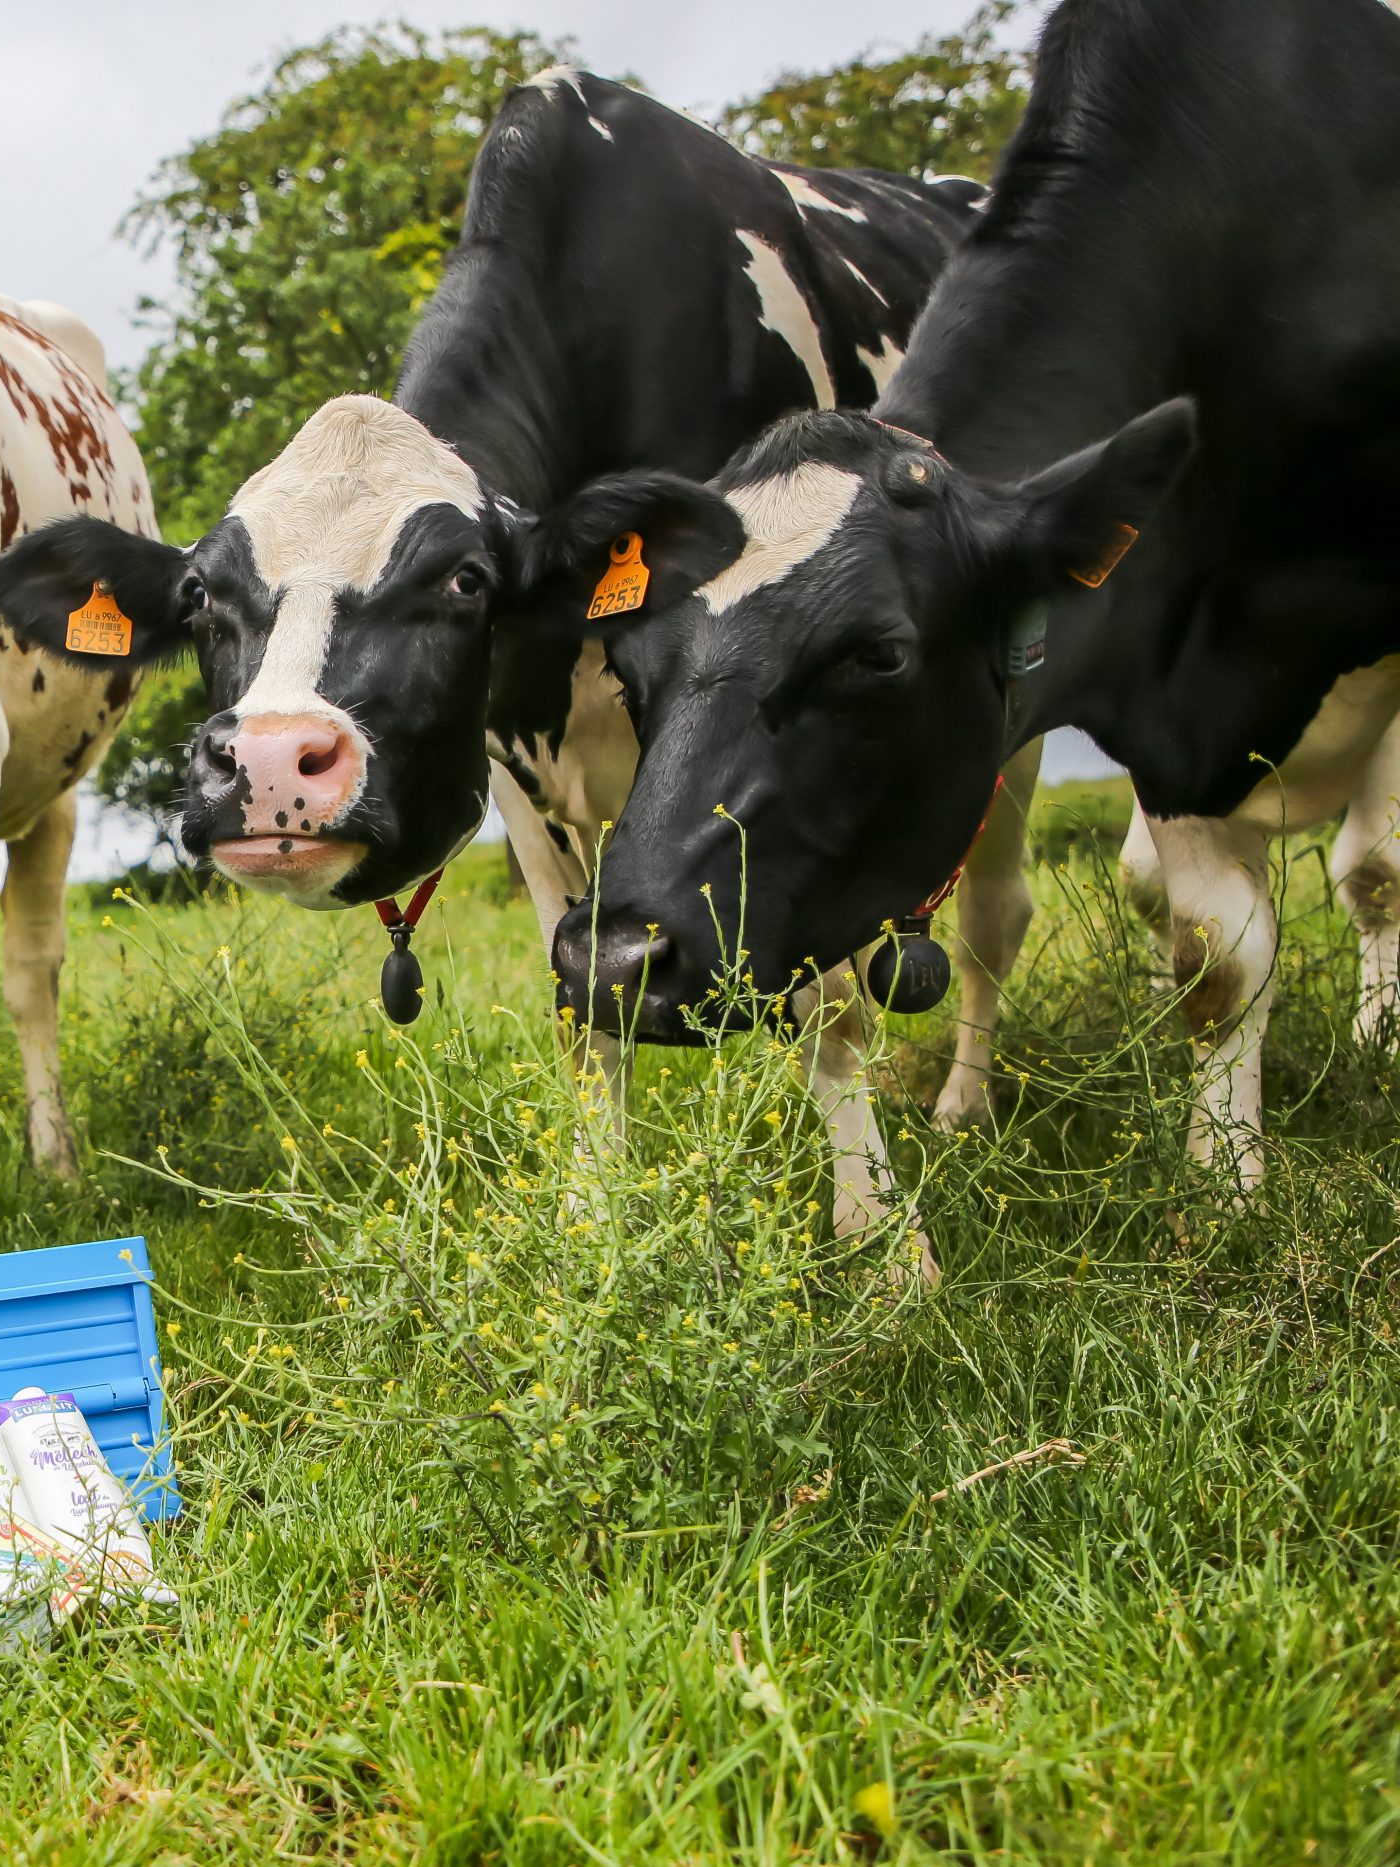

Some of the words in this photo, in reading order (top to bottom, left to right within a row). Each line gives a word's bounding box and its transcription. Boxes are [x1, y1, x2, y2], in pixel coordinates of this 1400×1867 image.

[590, 585, 641, 617] 6253
[81, 610, 93, 620] LU
[102, 612, 122, 623] 9967
[70, 628, 125, 653] 6253
[15, 1402, 73, 1417] LUXLAIT
[71, 1491, 101, 1506] lat
